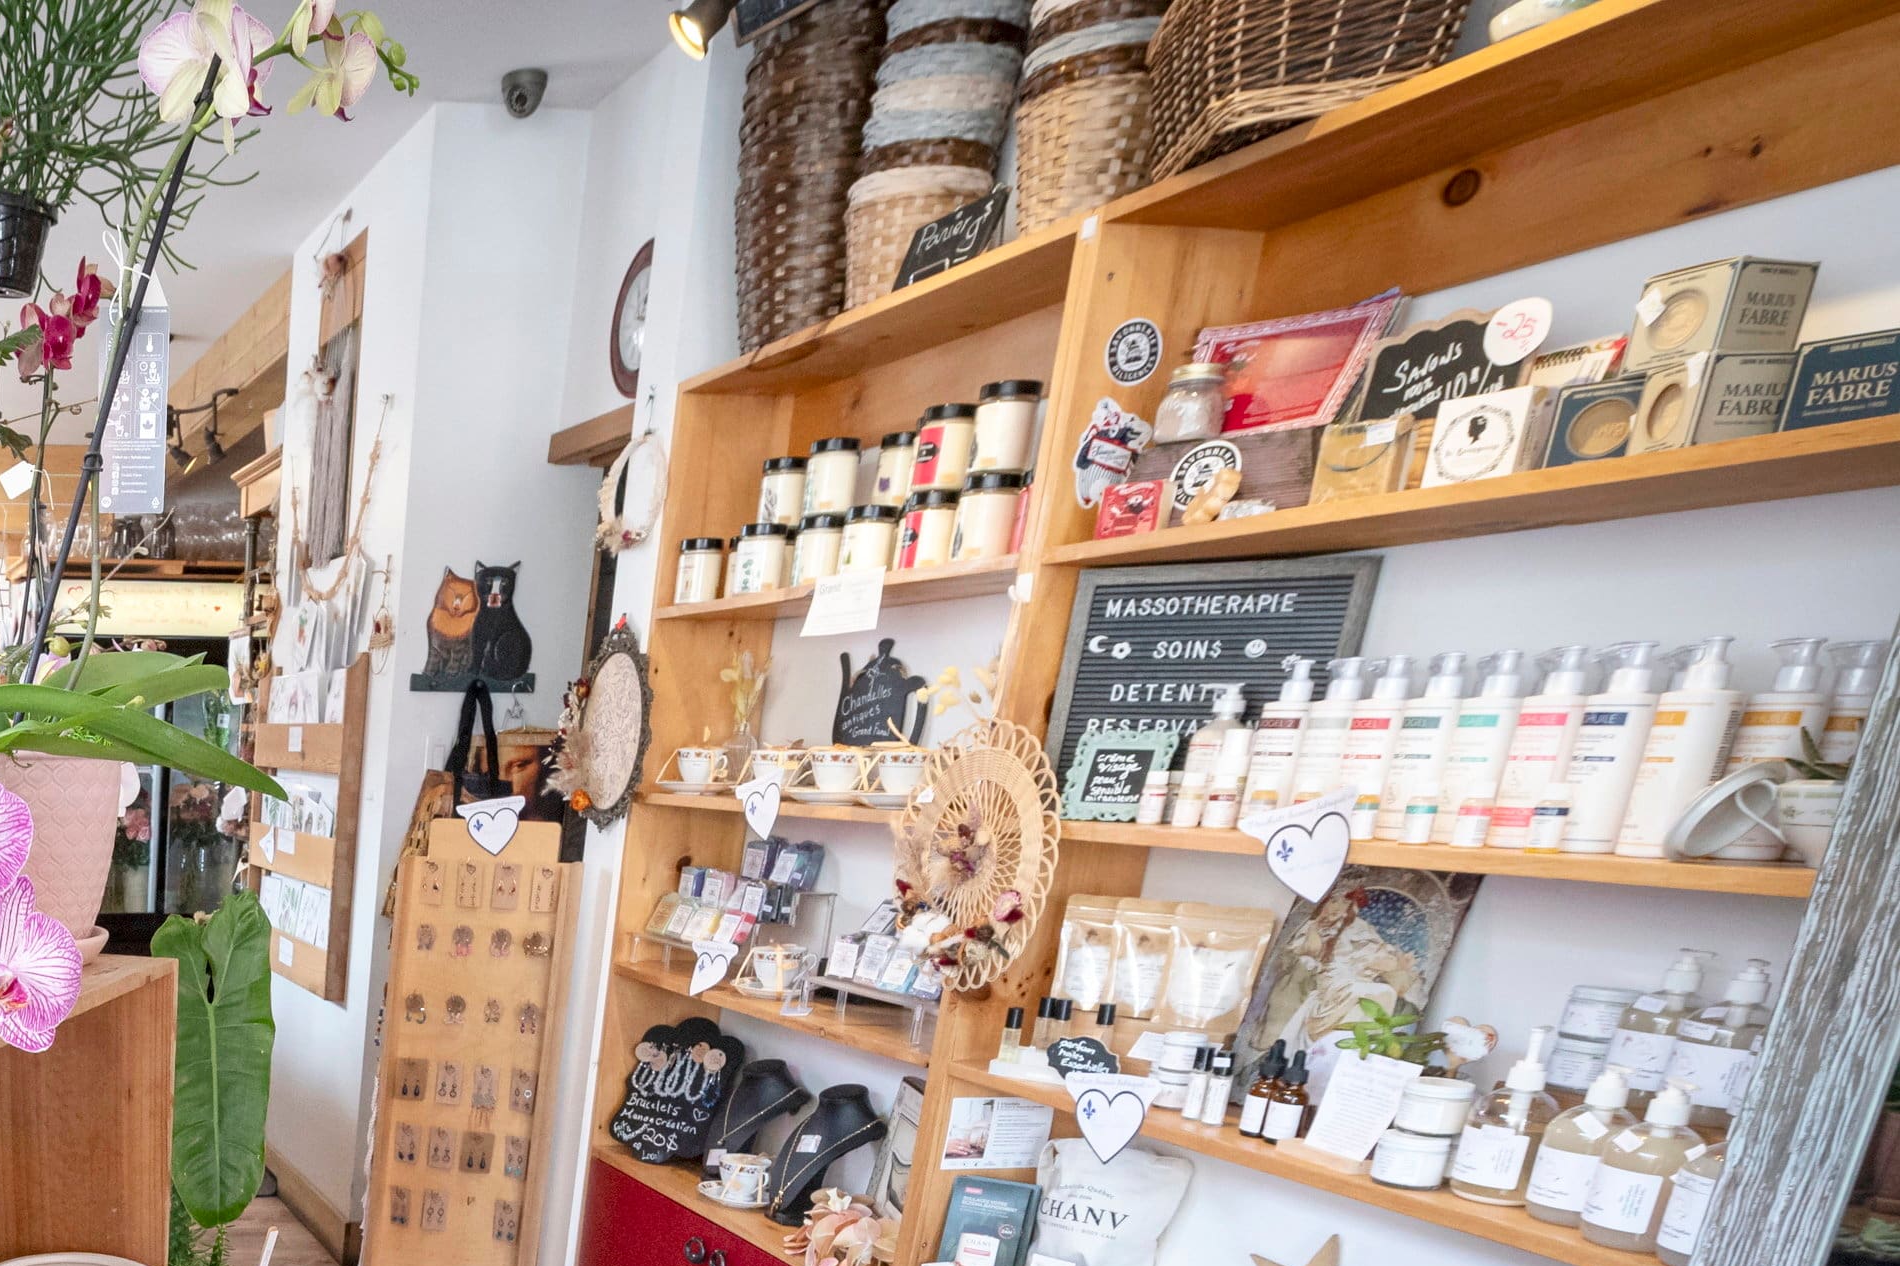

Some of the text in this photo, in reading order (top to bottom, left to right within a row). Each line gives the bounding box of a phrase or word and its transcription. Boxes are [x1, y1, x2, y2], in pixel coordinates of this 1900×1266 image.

[1746, 291, 1797, 308] MARIUS
[1738, 308, 1792, 327] FABRE
[1810, 360, 1900, 388] MARIUS
[1722, 382, 1785, 398] MARIU
[1804, 379, 1893, 407] FABRE
[1716, 399, 1781, 417] FABR
[1104, 592, 1299, 619] MASSOTHERAPIE
[641, 1127, 680, 1154] 20$
[1039, 1196, 1131, 1231] CHANV
